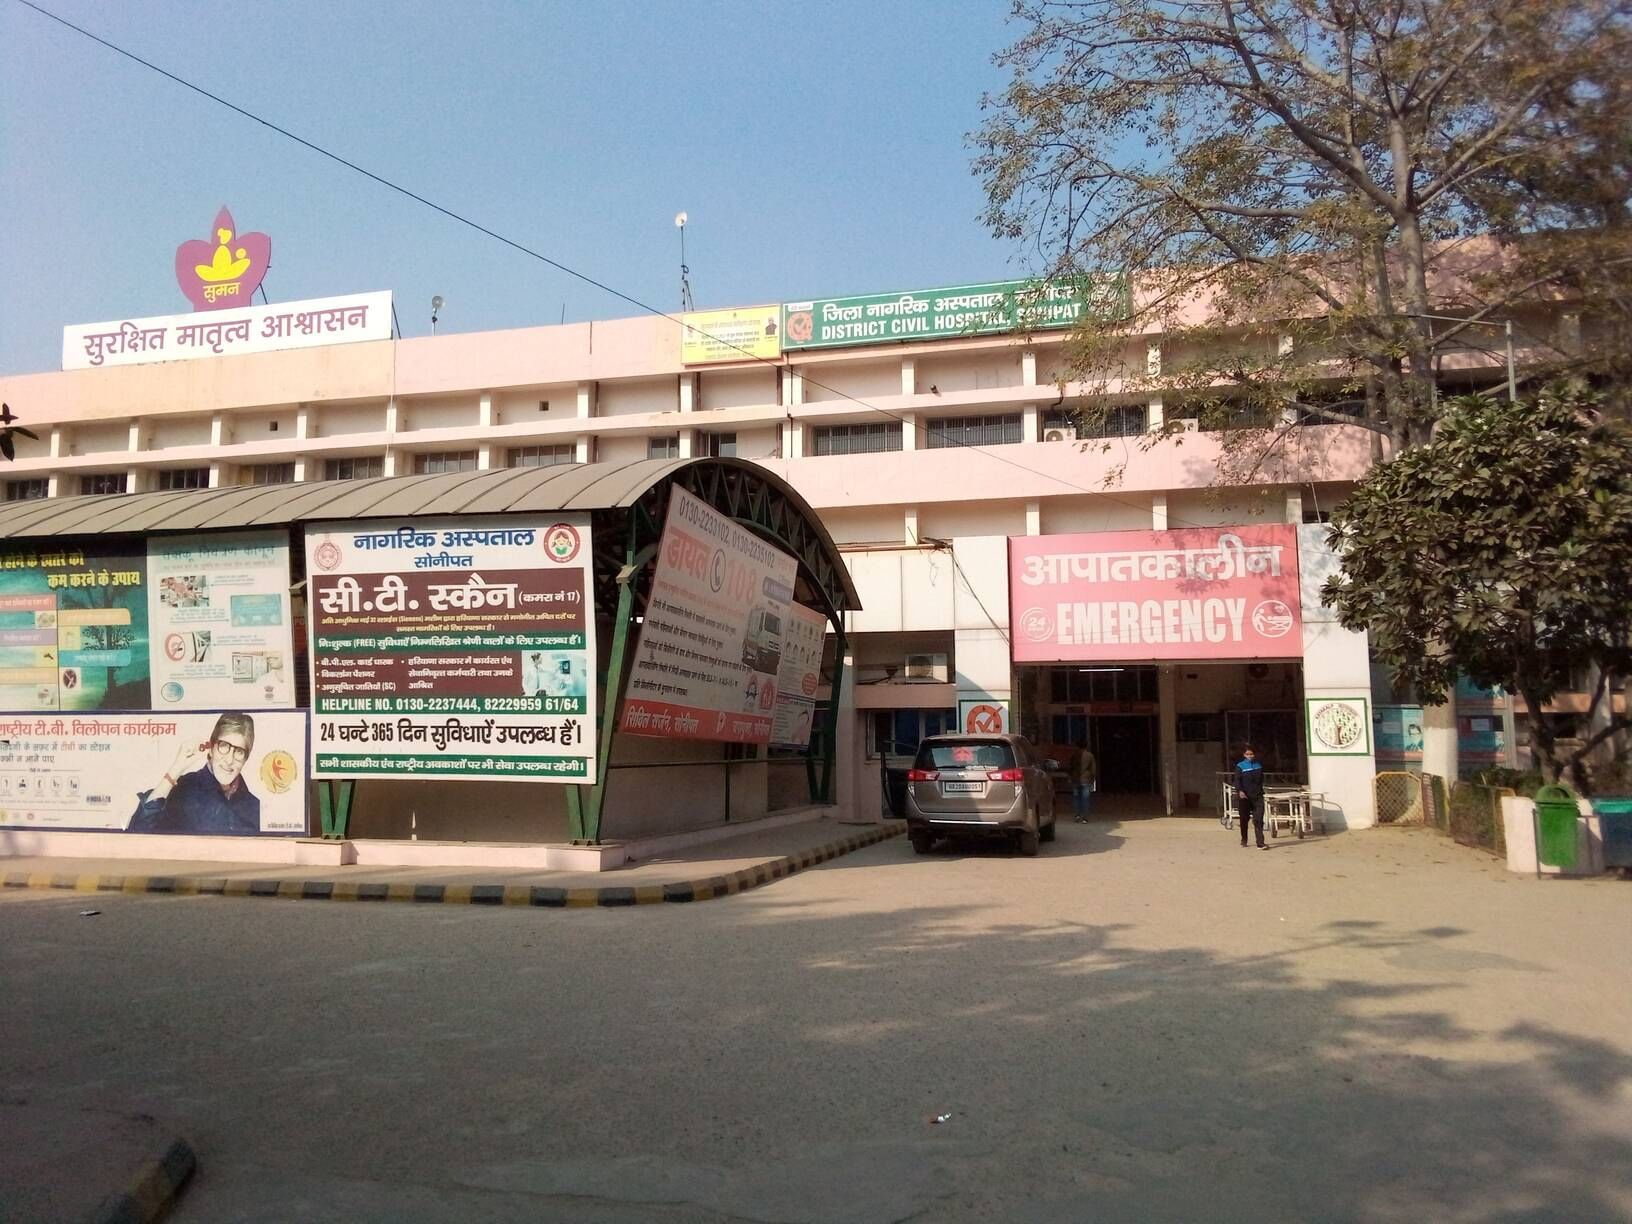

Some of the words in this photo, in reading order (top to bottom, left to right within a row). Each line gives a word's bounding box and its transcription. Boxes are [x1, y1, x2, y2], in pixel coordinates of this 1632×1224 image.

[203, 281, 241, 303] सुमन
[822, 303, 864, 322] जिला
[866, 296, 930, 318] नागरिक
[84, 322, 167, 366] सुरक्षित
[176, 319, 252, 354] मातृत्व
[261, 304, 369, 339] आश्वासन
[822, 320, 887, 341] DISTRICT
[891, 317, 930, 335] CIVIL
[353, 526, 438, 550] नागरिक
[441, 529, 536, 548] अस्पताल
[414, 552, 474, 568] सोनीपत
[1020, 533, 1283, 586] आपातकालीन
[47, 573, 68, 588] कम
[69, 569, 96, 587] करने
[98, 568, 109, 586] के
[111, 571, 140, 586] उपाय
[319, 575, 419, 613] सी.टी.
[427, 572, 519, 610] स्कैन
[1056, 598, 1247, 645] EMERGENCY
[354, 638, 376, 649] (FREE)
[504, 635, 515, 645] के
[516, 634, 534, 645] लिए
[382, 681, 396, 692] (SC)
[322, 697, 373, 711] HELPLINE
[374, 697, 394, 711] NO.
[396, 697, 482, 712] 0130-2237444,
[484, 697, 542, 711] 82229959
[544, 697, 579, 711] 61/64
[72, 719, 121, 736] विलोपन
[124, 718, 177, 738] कार्यक्रम
[320, 723, 335, 741] 24
[338, 718, 370, 742] घन्टे
[372, 723, 394, 741] 365
[397, 717, 428, 742] दिन
[496, 726, 557, 744] उपलब्ध
[319, 756, 339, 768] सभी
[341, 756, 380, 768] शासकीय
[468, 760, 481, 769] पर
[482, 758, 494, 769] भी
[516, 761, 551, 771] उपलब्ध
